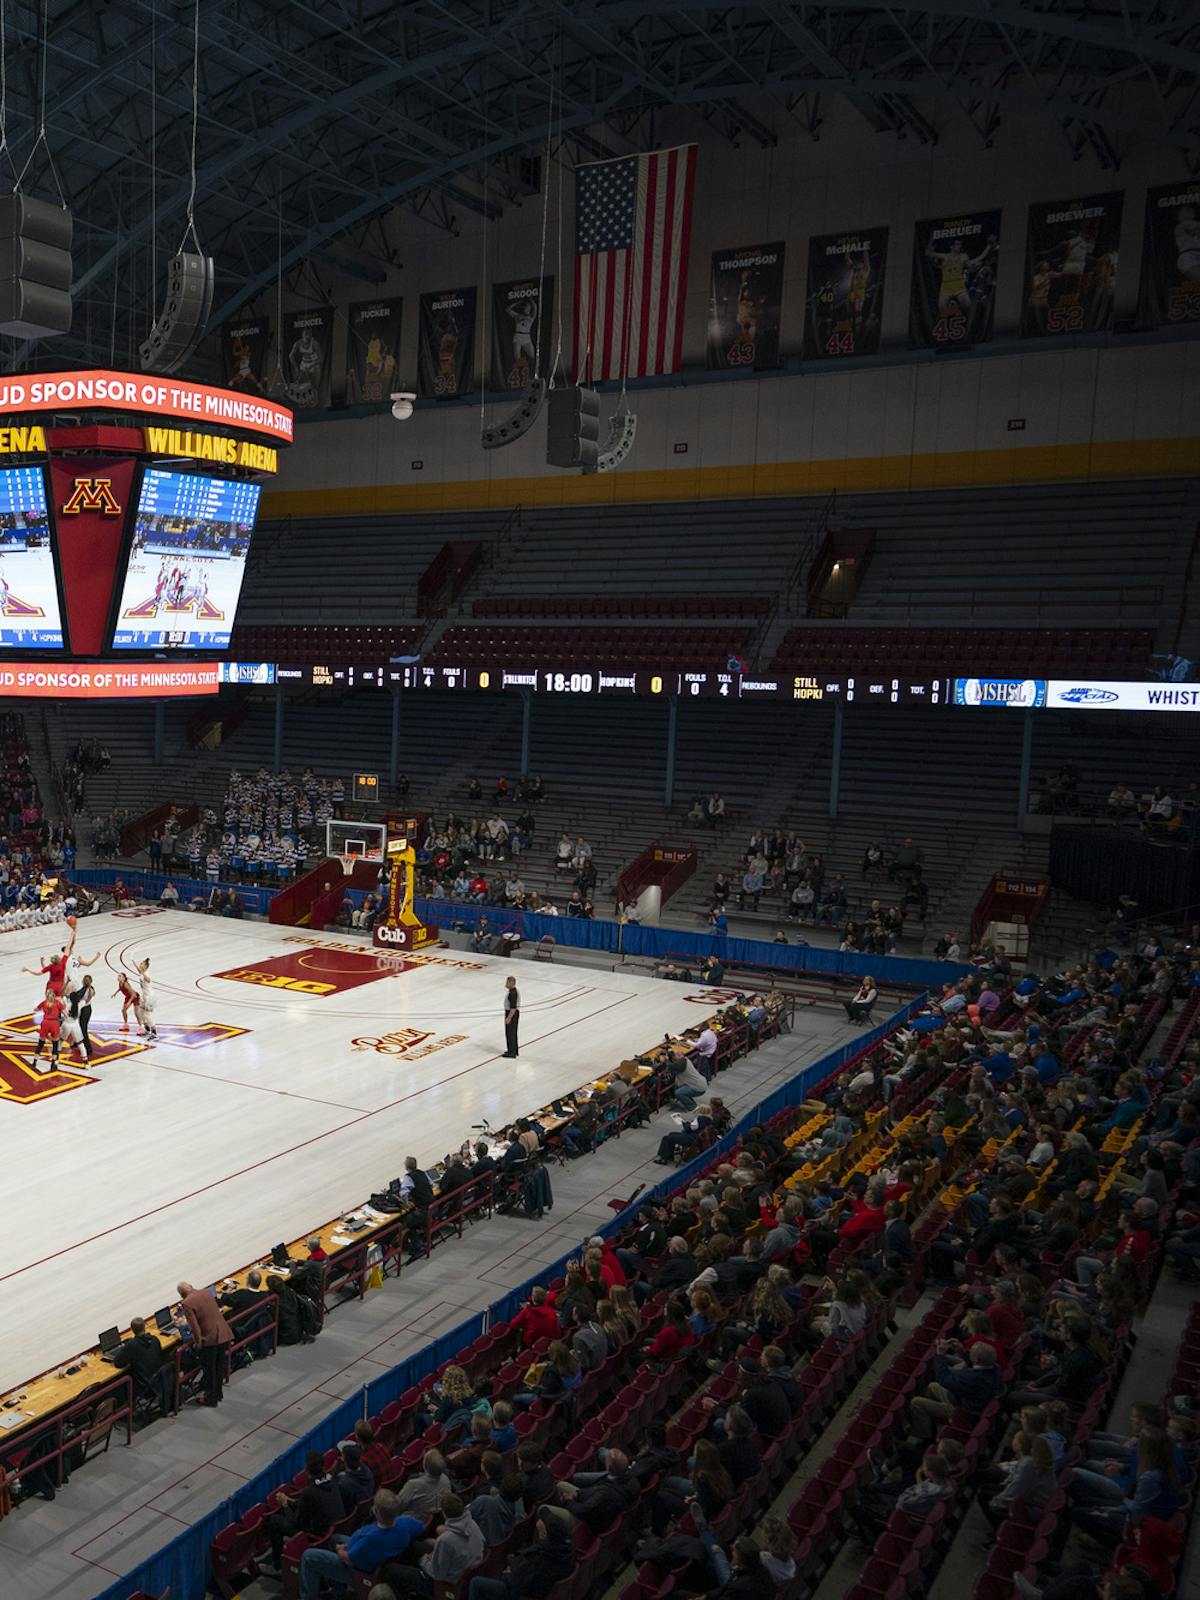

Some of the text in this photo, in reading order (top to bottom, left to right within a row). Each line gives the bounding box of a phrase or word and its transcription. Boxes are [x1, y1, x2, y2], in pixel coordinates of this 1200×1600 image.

[1046, 206, 1102, 224] BREWER
[933, 224, 982, 239] BREUER
[826, 241, 871, 255] McHALE
[719, 254, 777, 270] THOMPSON
[507, 288, 539, 300] SKOOG
[432, 298, 464, 311] BURTON
[360, 308, 390, 318] TUCKER
[1048, 305, 1084, 331] 52
[933, 316, 966, 341] 45
[826, 332, 855, 354] 44
[727, 342, 756, 366] 43
[434, 375, 457, 394] 34
[30, 379, 137, 404] SPONSOR
[141, 385, 167, 406] OF
[170, 389, 201, 412] THE
[205, 395, 273, 428] MINNESOTA
[274, 412, 293, 436] STATE
[147, 427, 277, 473] WILLIAMS ARENA
[63, 479, 121, 514] M
[313, 666, 329, 675] STILL
[443, 668, 460, 676] FOULS
[17, 672, 91, 688] SPONSOR
[94, 672, 112, 686] OF
[114, 672, 138, 686] THE
[140, 671, 197, 686] MINNESOTA
[197, 671, 216, 685] STATE
[313, 675, 333, 684] HOPKI
[424, 676, 431, 687] 4
[448, 676, 455, 688] 0
[479, 672, 489, 688] 0
[544, 673, 593, 693] 18:00
[600, 677, 635, 687] HOPKINS
[685, 673, 706, 682] FOULS
[794, 677, 818, 688] STILL
[847, 678, 854, 689] 0
[651, 676, 662, 693] 0
[691, 683, 699, 695] 0
[720, 683, 729, 696] 4
[742, 682, 777, 690] REBOUNDS
[892, 679, 898, 690] 0
[932, 680, 939, 691] 0
[793, 688, 823, 699] HOPKI
[847, 690, 853, 701] 0
[891, 691, 898, 702] 0
[931, 692, 938, 704] 0
[974, 682, 1028, 703] MSHSL
[1059, 692, 1113, 700] OFFICIAL
[1148, 690, 1200, 705] WHIST
[377, 926, 407, 944] Cub
[281, 935, 488, 970] GOLDEN GOPHERS
[351, 1028, 435, 1054] Barn
